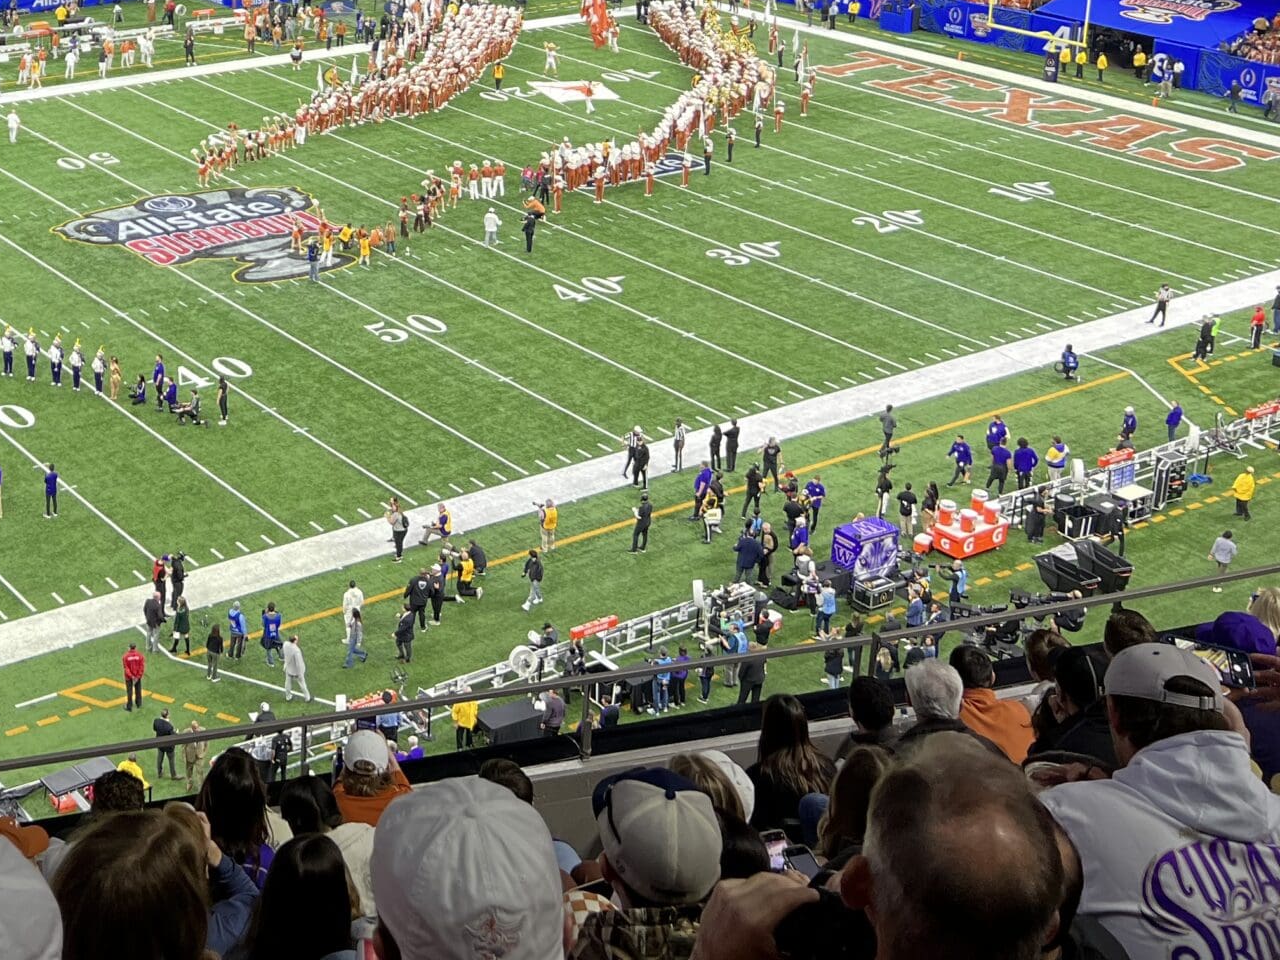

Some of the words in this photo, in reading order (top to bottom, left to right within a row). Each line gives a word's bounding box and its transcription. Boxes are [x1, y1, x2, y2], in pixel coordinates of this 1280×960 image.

[814, 50, 1280, 172] TEXAS
[56, 151, 120, 170] 50
[116, 200, 281, 240] Allstate
[851, 209, 924, 234] 20
[705, 242, 781, 266] 30
[552, 275, 623, 303] 40
[363, 314, 448, 343] 50
[177, 356, 252, 390] 40
[940, 538, 951, 550] G
[962, 537, 975, 553] G
[992, 527, 1004, 543] G
[833, 543, 856, 567] W
